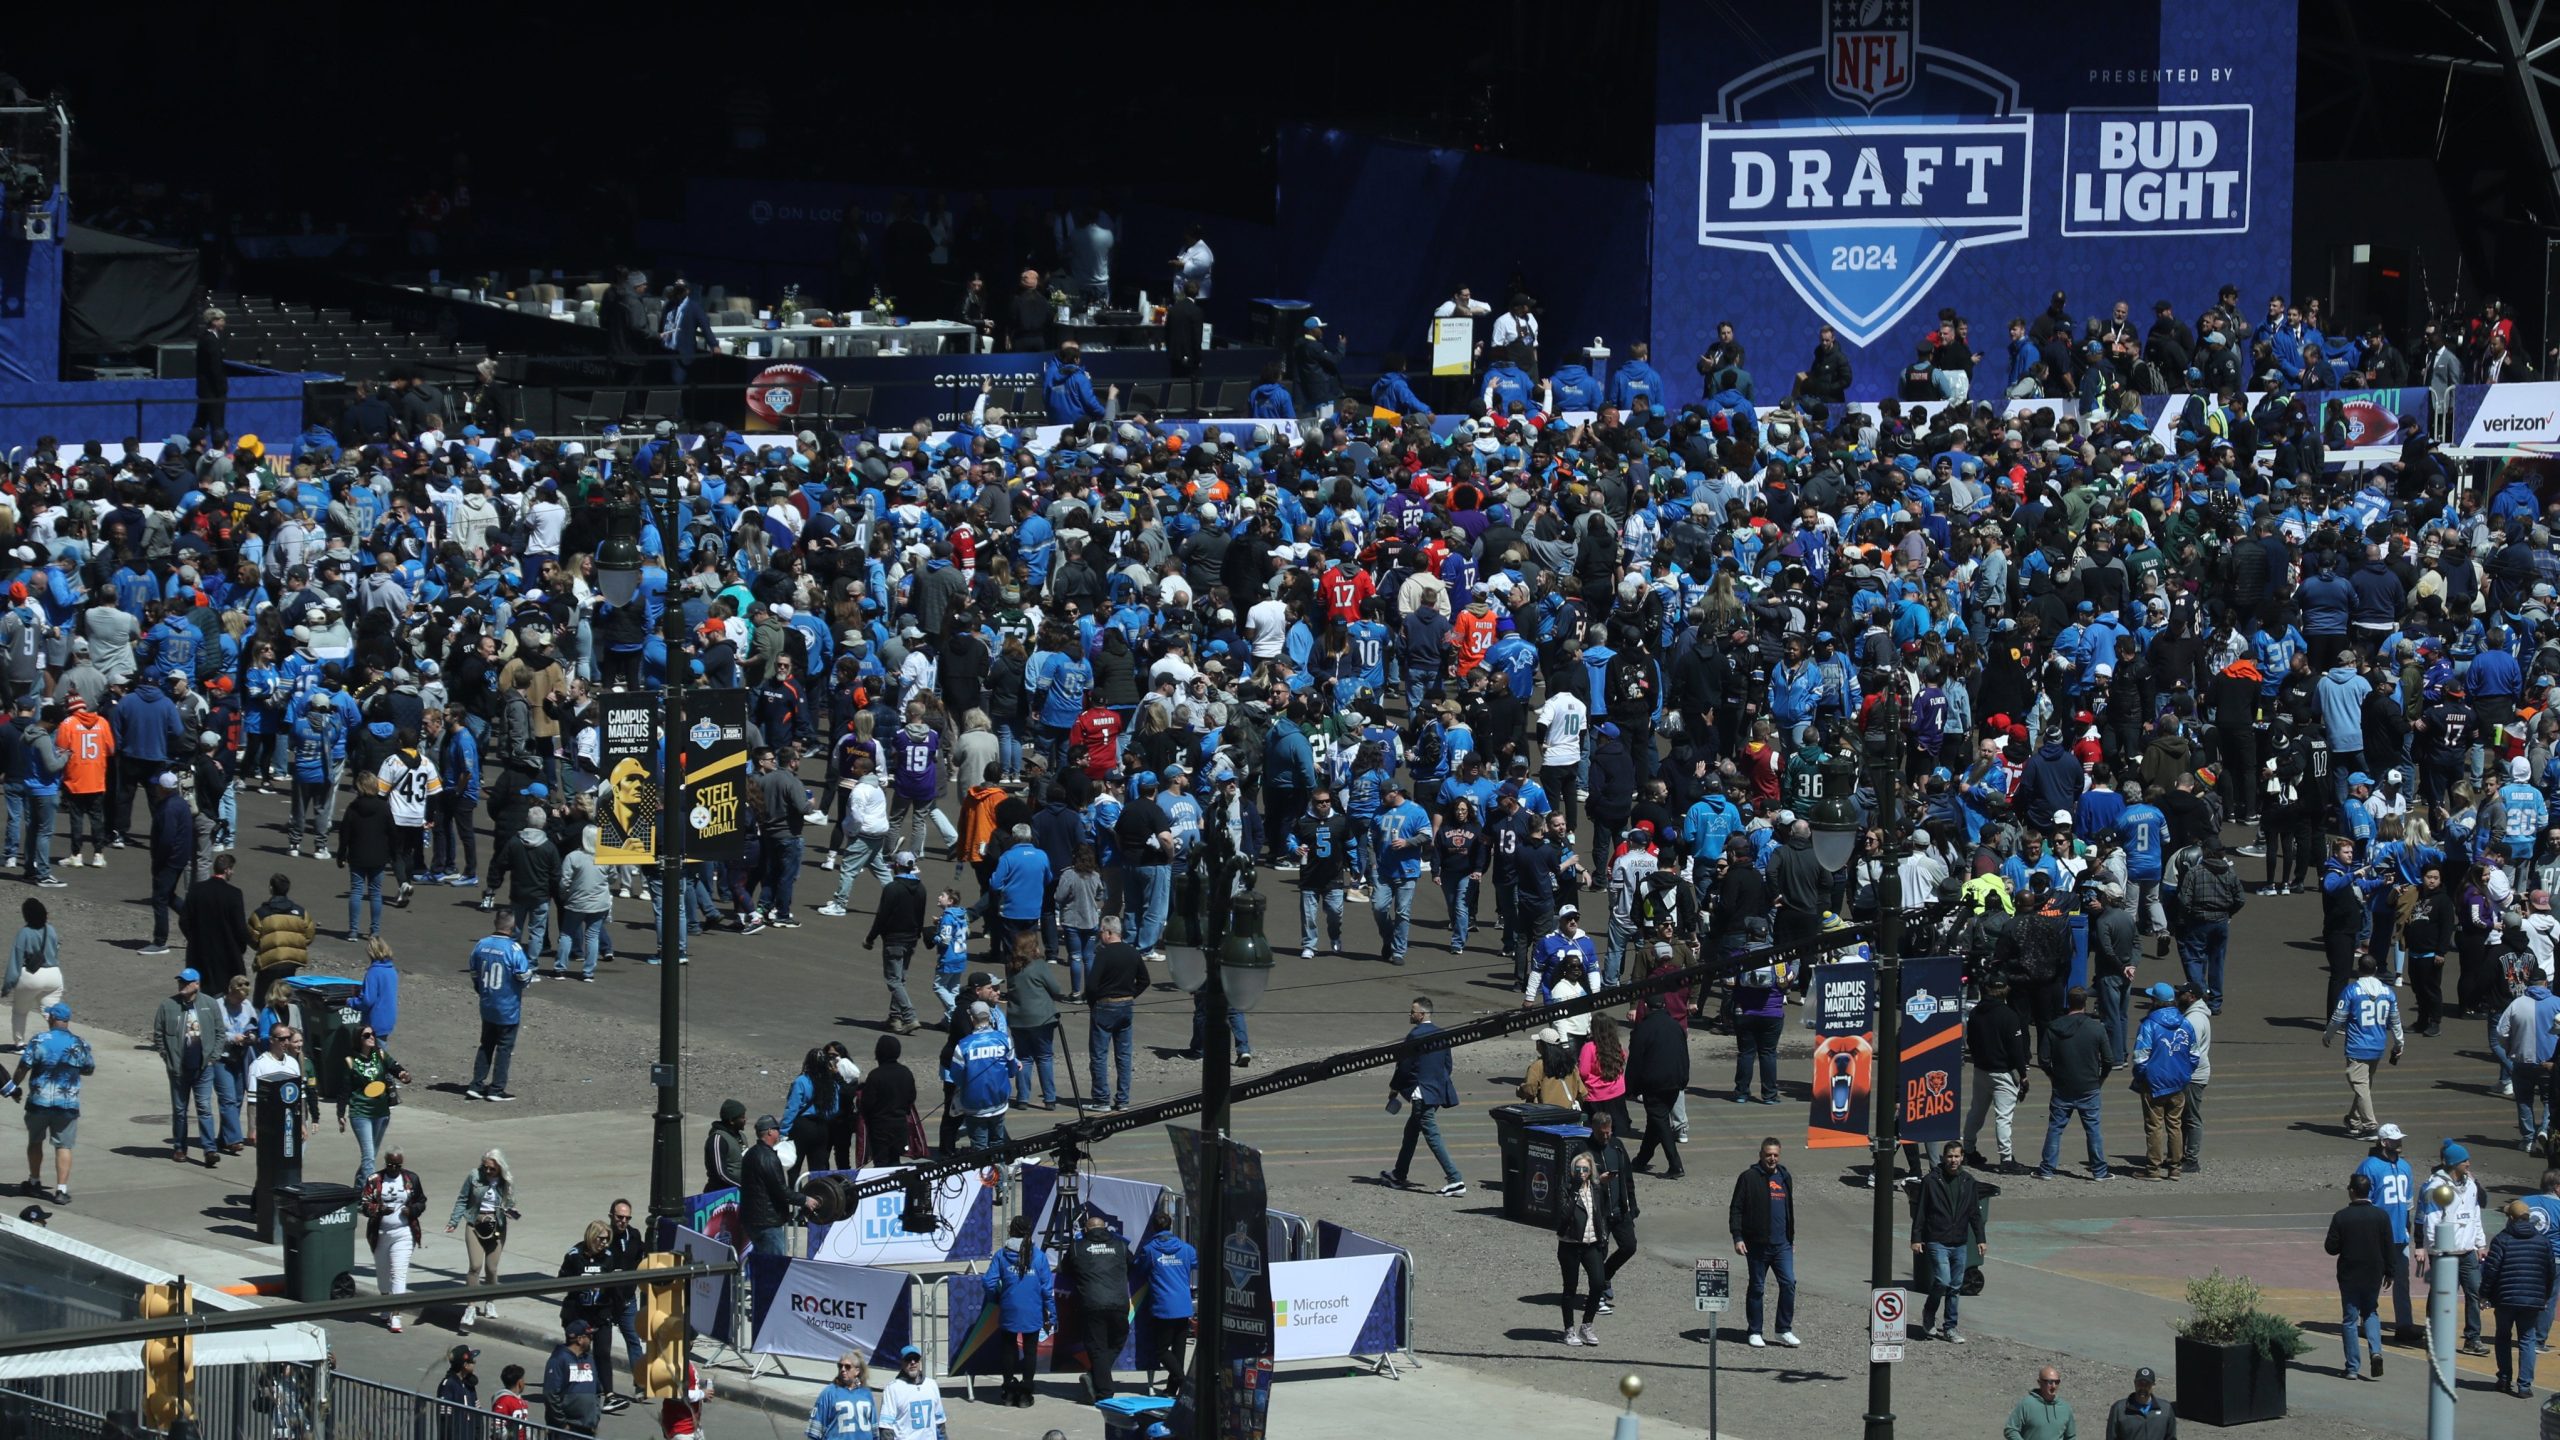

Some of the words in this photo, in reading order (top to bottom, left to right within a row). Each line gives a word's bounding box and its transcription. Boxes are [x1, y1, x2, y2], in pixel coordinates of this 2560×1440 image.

[1836, 34, 1905, 94] NFL
[2089, 69, 2199, 83] PRESENTED
[2211, 67, 2233, 82] BY
[2099, 120, 2218, 170] BUD
[1728, 146, 2004, 209] DRAFT
[2074, 171, 2239, 222] LIGHT
[1831, 244, 1898, 271] 2024
[2483, 416, 2546, 433] verizon
[1333, 585, 1354, 607] 17
[24, 628, 34, 656] 9
[1472, 631, 1493, 653] 34
[608, 708, 649, 724] CAMPUS
[1564, 714, 1579, 736] 10
[1935, 708, 1943, 730] 4
[608, 723, 649, 739] MARTIUS
[2444, 725, 2465, 746] 17
[81, 733, 98, 759] 15
[906, 745, 929, 772] 19
[400, 772, 428, 803] 43
[696, 782, 737, 805] STEEL
[1798, 773, 1824, 798] 36
[710, 799, 739, 824] CITY
[2507, 808, 2536, 836] 20
[699, 820, 738, 839] FOOTBALL
[1381, 814, 1405, 842] 97
[2137, 824, 2149, 851] 9
[1316, 832, 1332, 858] 5
[1500, 829, 1516, 854] 13
[1631, 860, 1655, 868] PARSONS
[1825, 980, 1866, 996] CAMPUS
[1824, 996, 1865, 1013] MARTIUS
[1909, 1003, 1935, 1011] DRAFT
[2361, 1000, 2390, 1027] 20
[342, 1014, 361, 1025] SMA
[1825, 1021, 1845, 1029] APRIL
[1846, 1020, 1864, 1028] 25-27
[969, 1045, 1006, 1061] LIONS
[285, 1085, 293, 1101] P
[1908, 1078, 1926, 1100] DA
[1907, 1090, 1954, 1122] BEARS
[2383, 1174, 2408, 1204] 20
[876, 1196, 906, 1217] BU
[319, 1212, 351, 1225] SMART
[1225, 1249, 1258, 1269] DRAFT
[1697, 1259, 1714, 1269] ZONE
[791, 1294, 868, 1320] ROCKET
[1225, 1286, 1256, 1309] DETROIT
[1293, 1295, 1350, 1312] Microsoft
[806, 1315, 853, 1333] Mortgage
[1236, 1318, 1265, 1333] LIGHT
[1293, 1312, 1338, 1326] Surface
[1884, 1323, 1894, 1331] NO
[1874, 1330, 1904, 1339] STANDING
[835, 1400, 872, 1433] 20
[910, 1399, 932, 1430] 97
